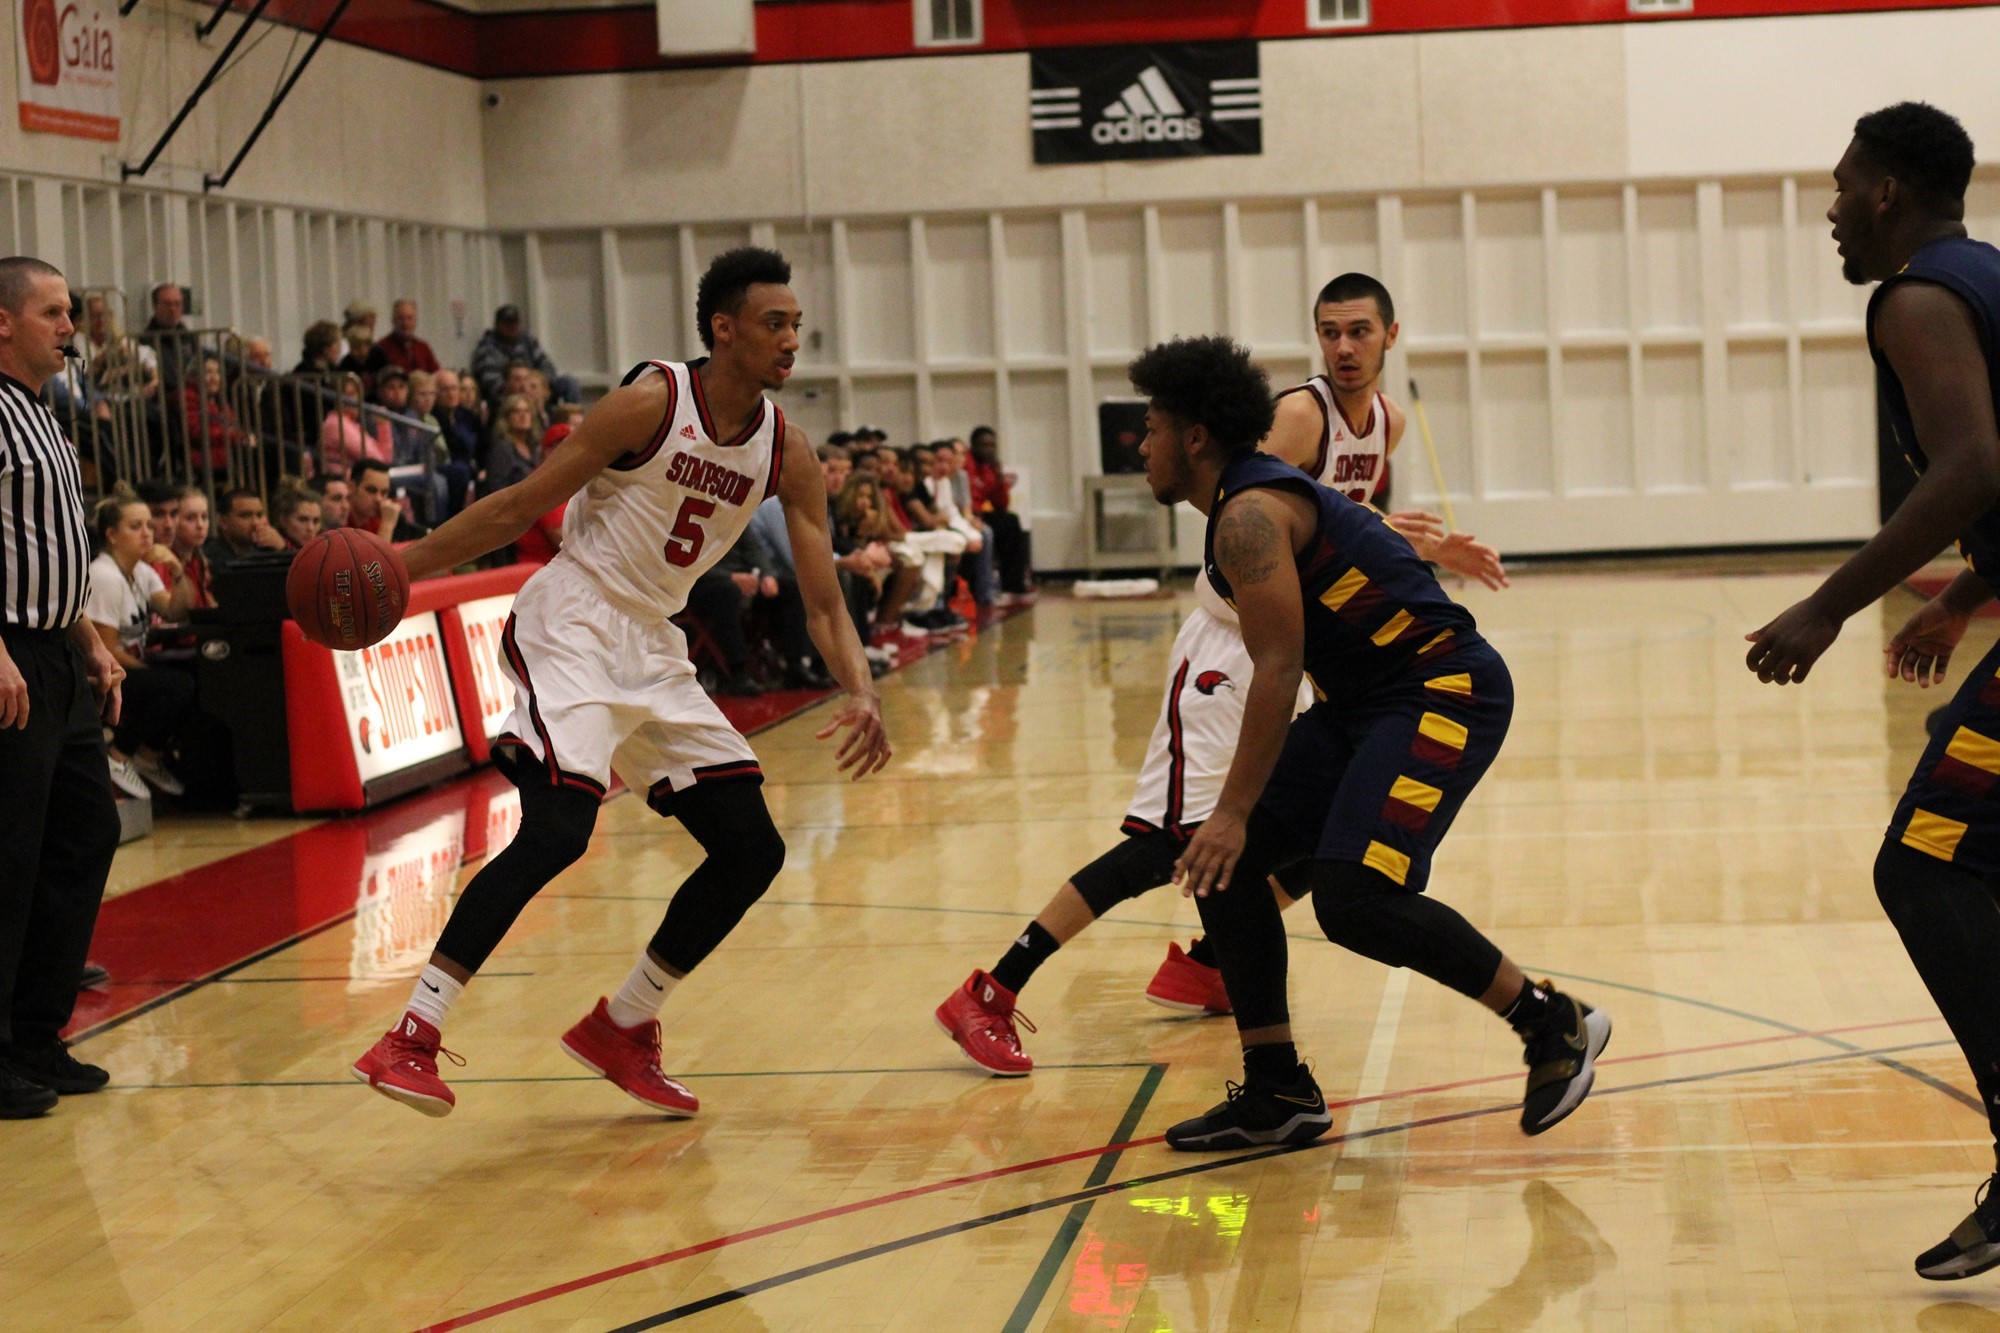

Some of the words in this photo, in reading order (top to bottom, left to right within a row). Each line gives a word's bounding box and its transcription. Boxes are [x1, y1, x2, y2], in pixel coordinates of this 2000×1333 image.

[60, 3, 114, 71] Gaia
[1091, 115, 1202, 144] adidas
[665, 451, 755, 507] SIMPSON
[664, 496, 717, 568] 5
[335, 569, 358, 644] TF-1000
[361, 634, 454, 749] SIMPSON
